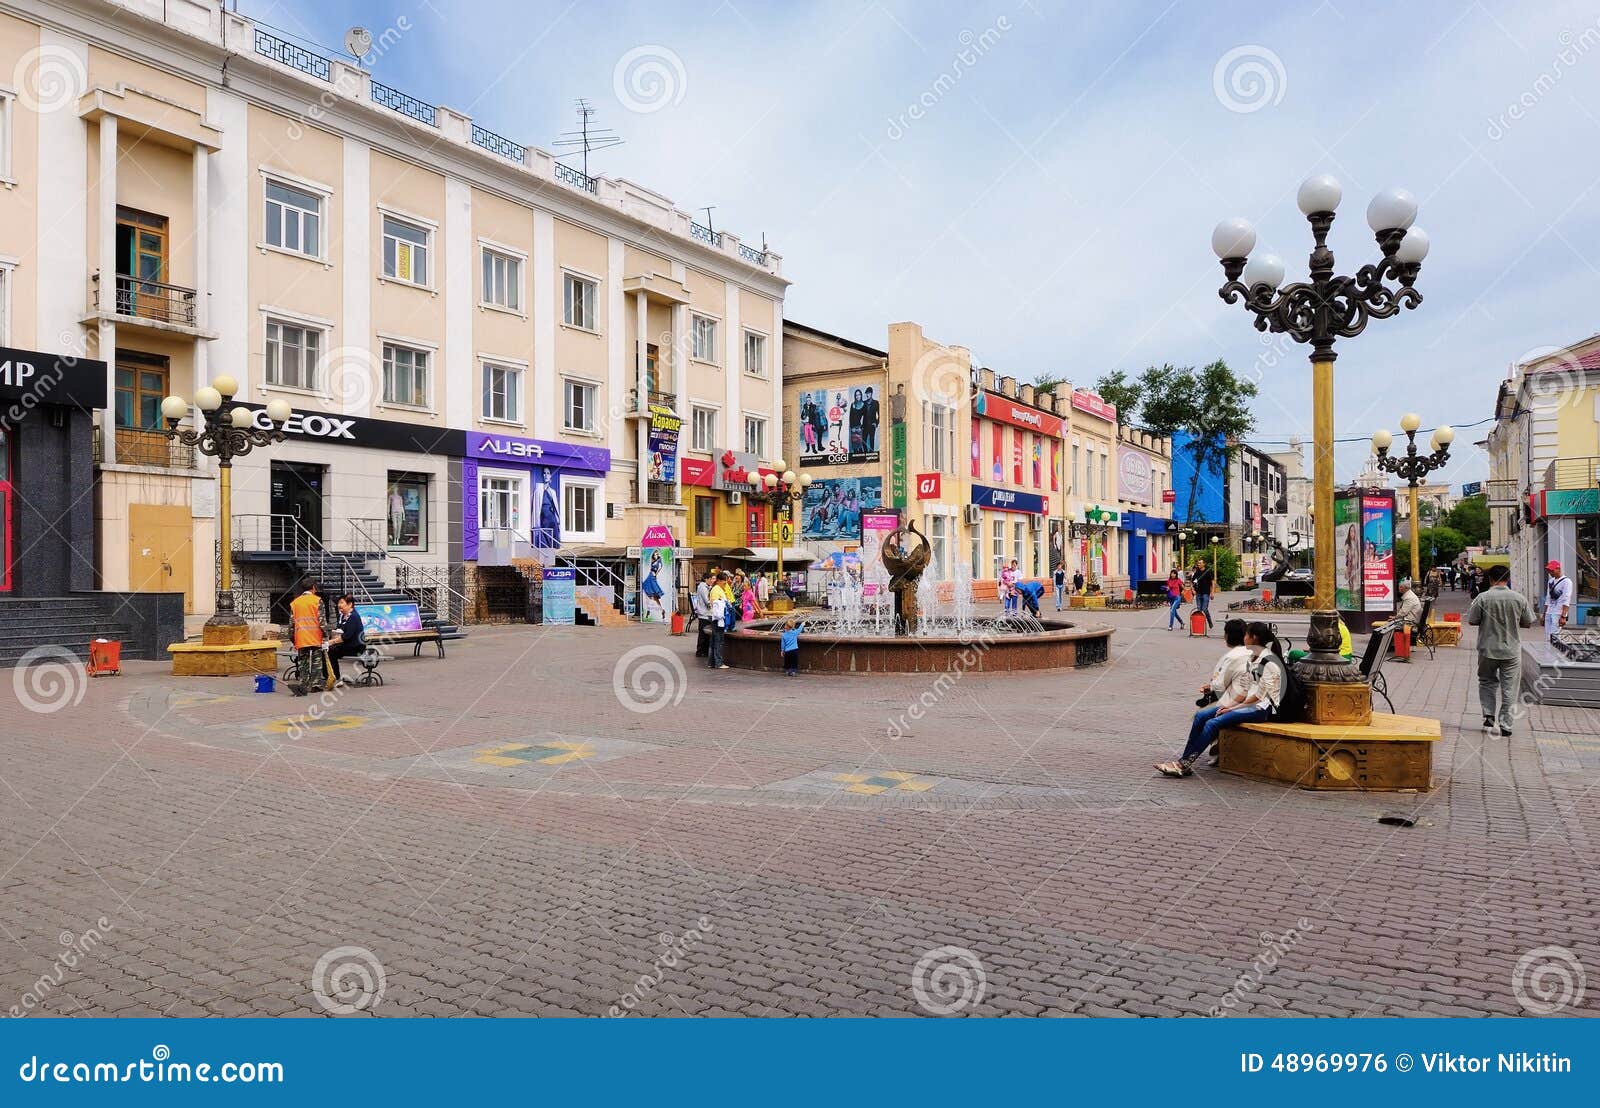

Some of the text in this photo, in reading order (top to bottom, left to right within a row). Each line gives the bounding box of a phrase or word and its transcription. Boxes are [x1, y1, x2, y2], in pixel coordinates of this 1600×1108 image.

[251, 409, 356, 439] GEOX
[893, 458, 902, 498] SELA
[463, 461, 478, 549] Welcome!
